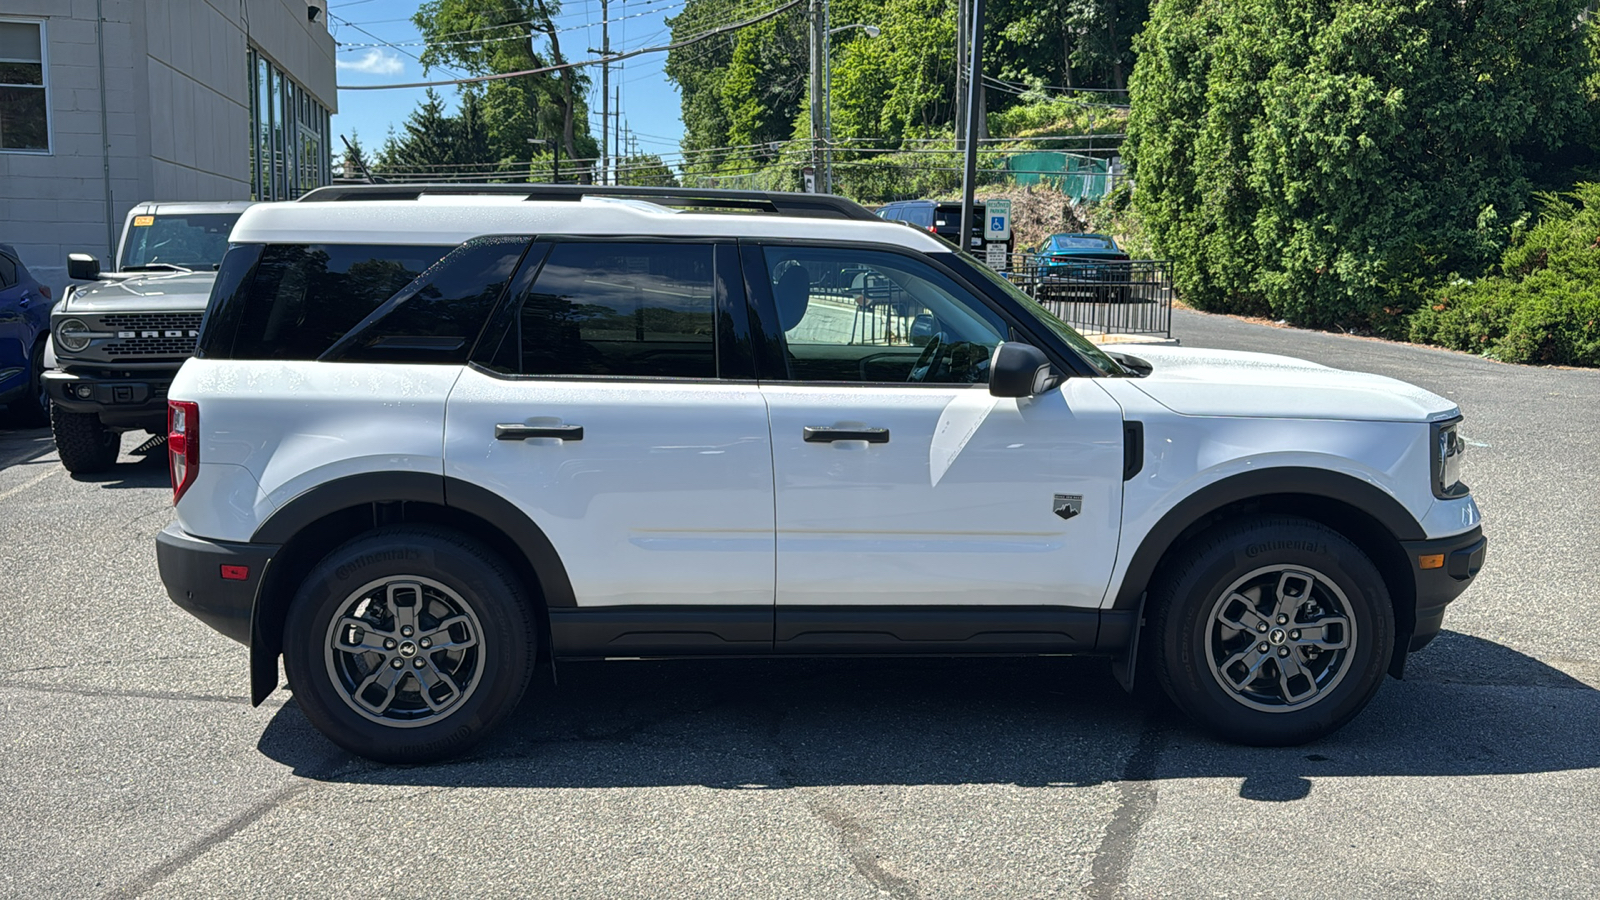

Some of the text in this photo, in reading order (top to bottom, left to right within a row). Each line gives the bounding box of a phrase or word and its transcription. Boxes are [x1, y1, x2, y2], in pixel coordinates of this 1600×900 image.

[118, 330, 200, 339] BRON
[1245, 540, 1319, 558] Continental
[335, 547, 409, 580] Continental
